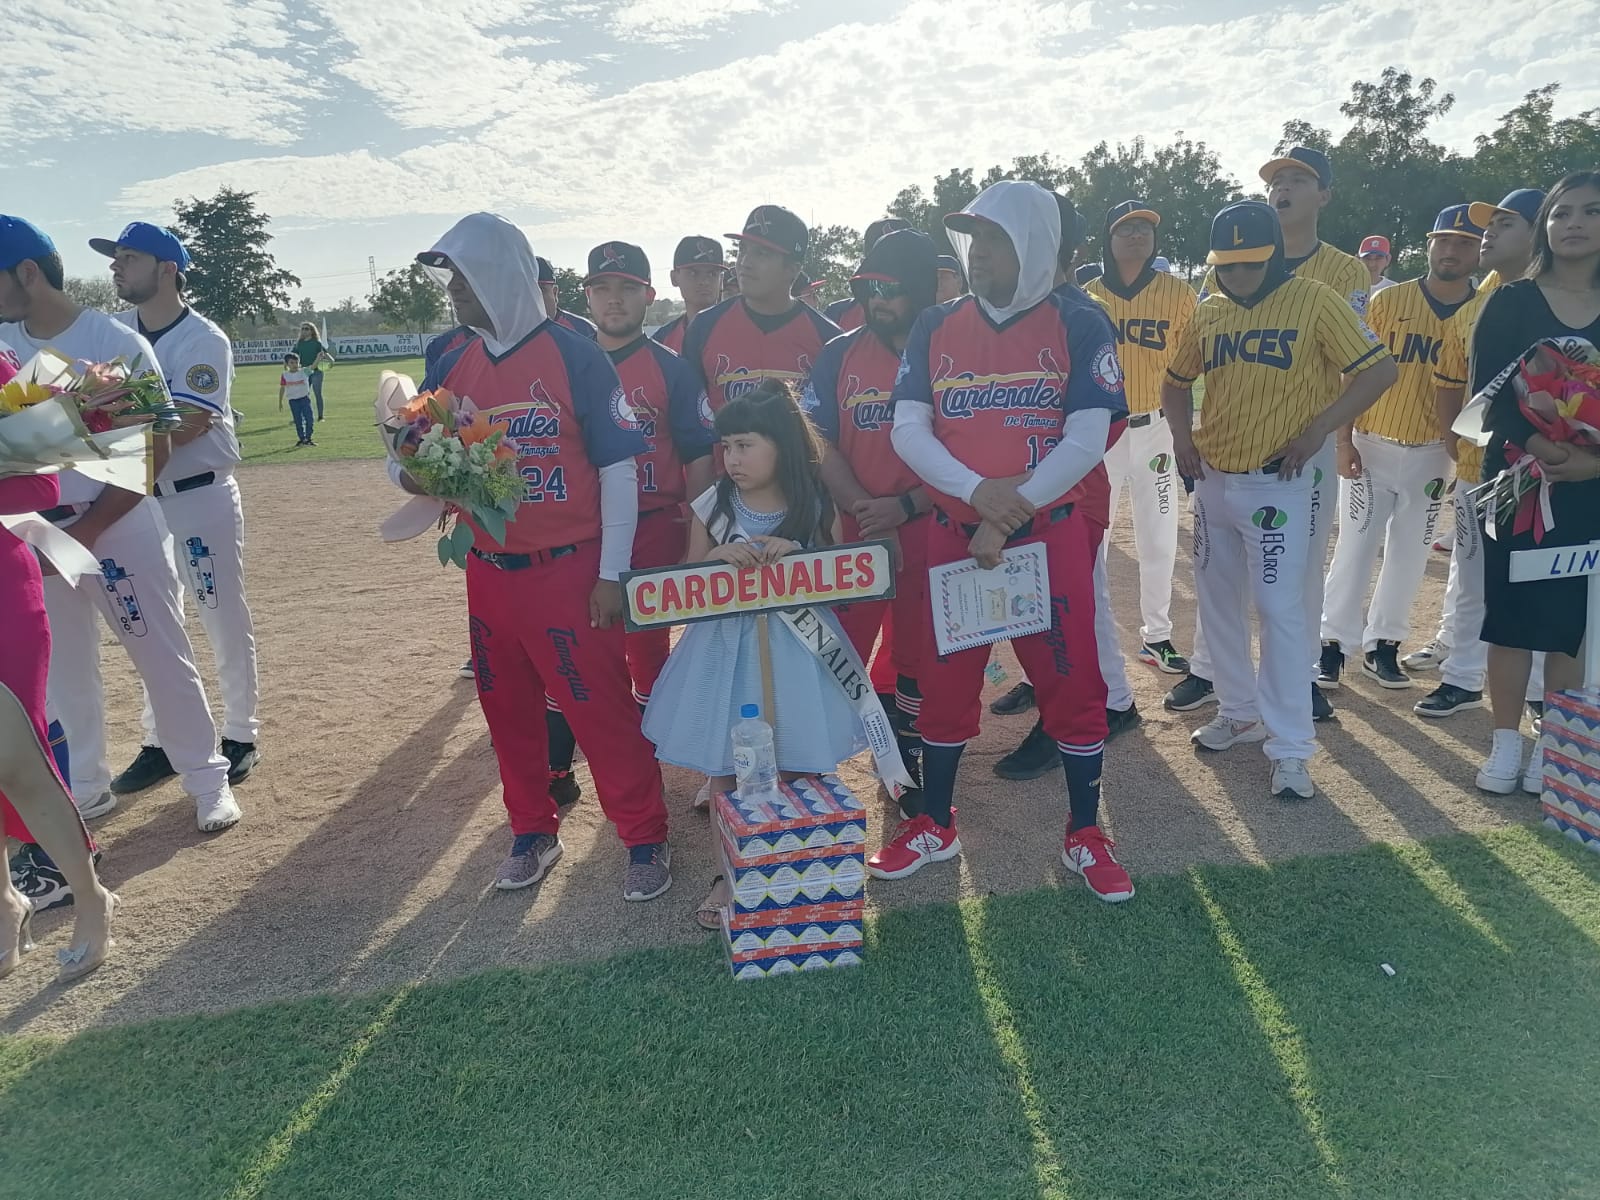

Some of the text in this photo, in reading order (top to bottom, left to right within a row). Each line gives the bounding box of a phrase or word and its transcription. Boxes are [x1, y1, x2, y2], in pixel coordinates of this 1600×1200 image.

[1233, 224, 1244, 246] L
[338, 343, 390, 354] LA RANA
[1202, 329, 1298, 376] LINCES
[940, 371, 1063, 418] Cardenales
[520, 466, 567, 502] 24
[1550, 549, 1600, 575] LIN
[635, 551, 876, 617] CARDENALES
[784, 608, 869, 701] ENALES
